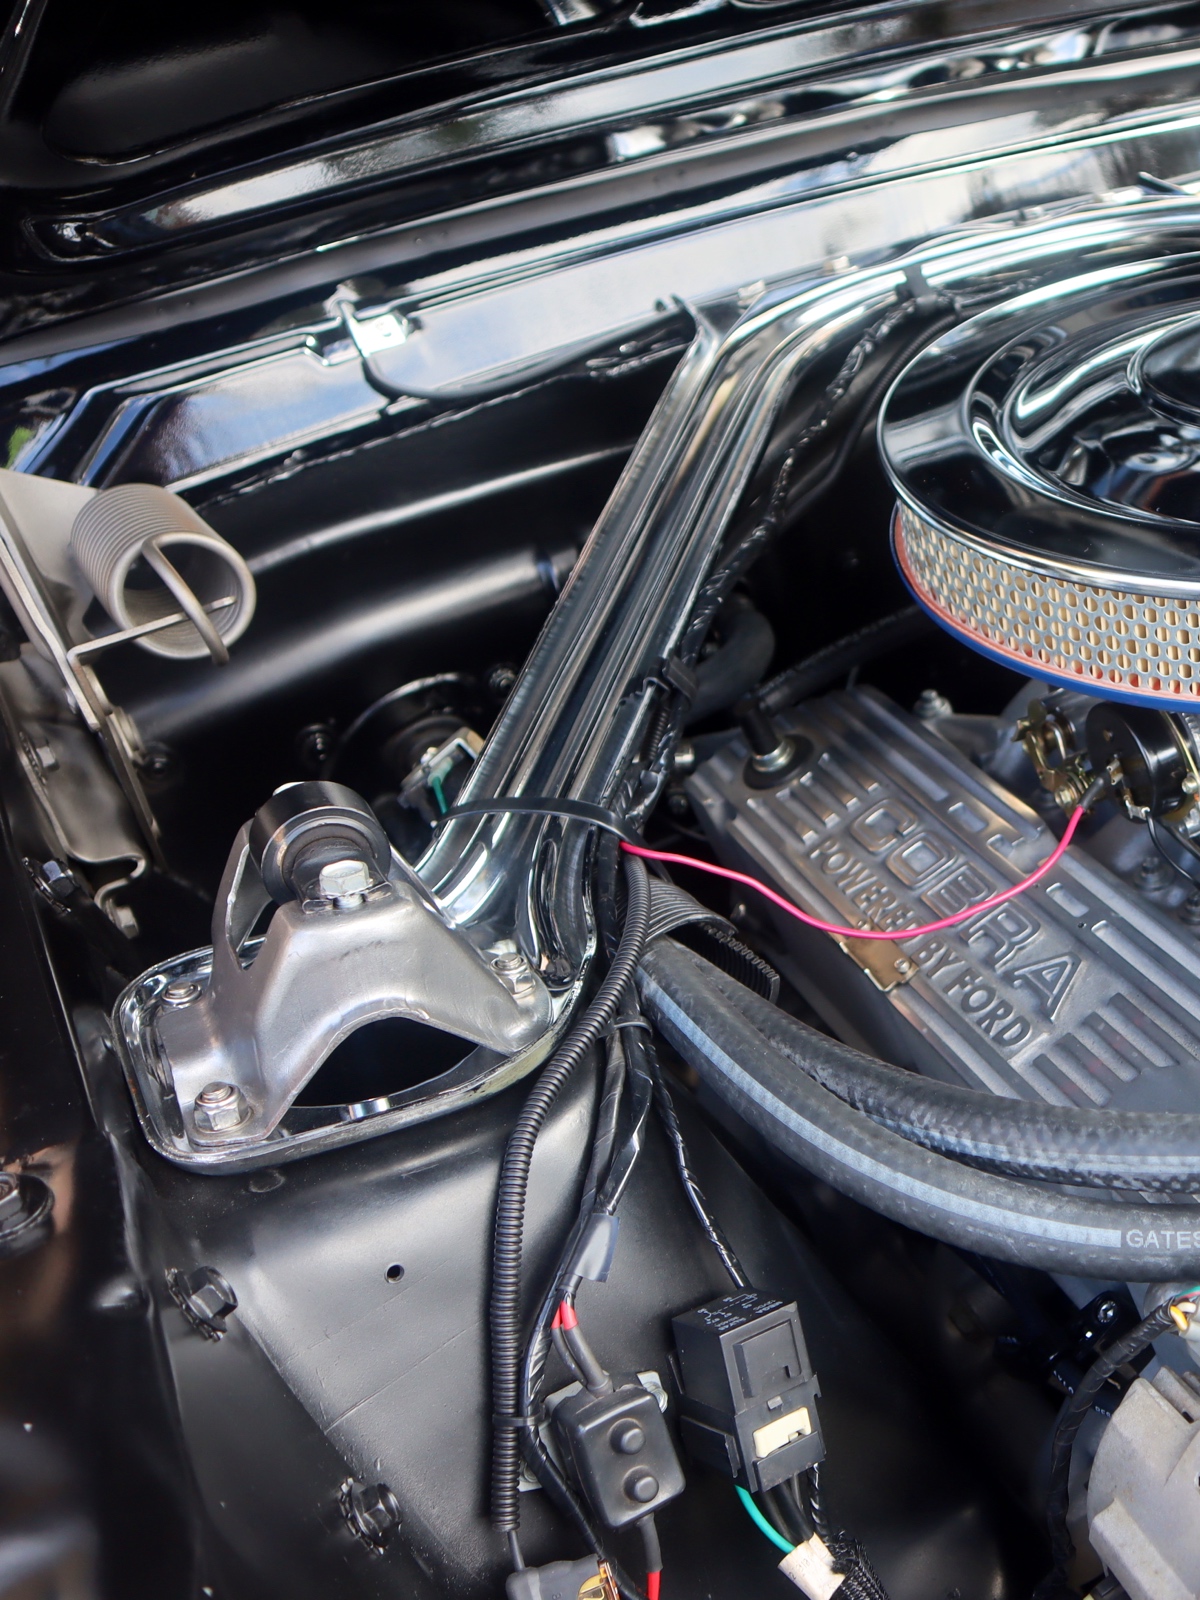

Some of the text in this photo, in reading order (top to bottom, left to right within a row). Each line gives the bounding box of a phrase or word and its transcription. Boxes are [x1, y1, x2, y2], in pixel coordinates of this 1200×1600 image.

[808, 840, 1032, 1050] POWERED BY FORD
[850, 799, 1084, 1023] COBRA
